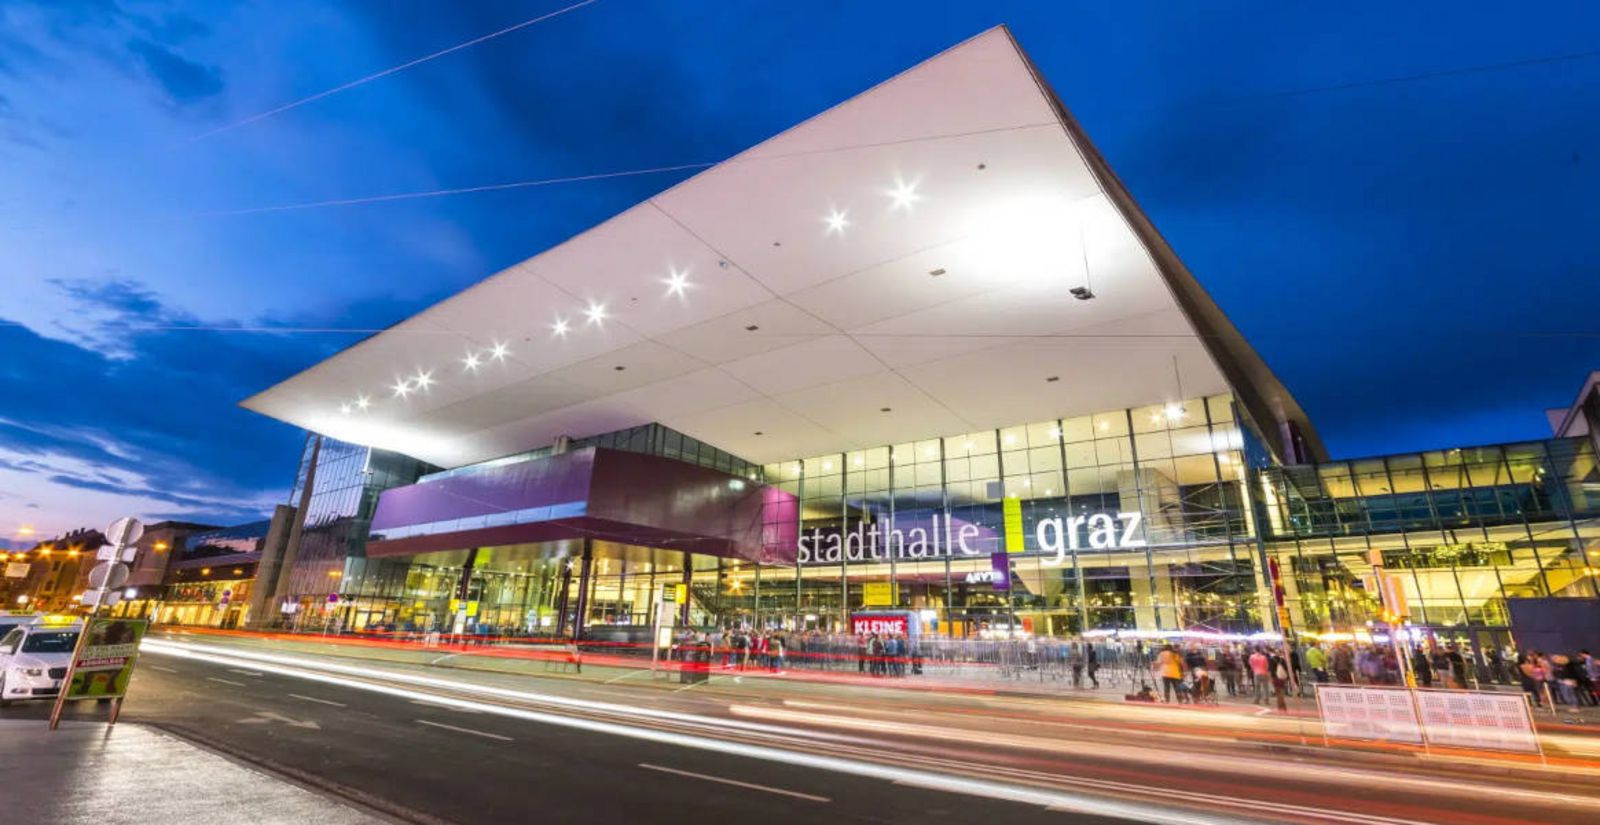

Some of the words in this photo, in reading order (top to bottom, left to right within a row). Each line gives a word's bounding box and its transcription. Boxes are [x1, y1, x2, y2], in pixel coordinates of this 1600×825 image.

[797, 513, 980, 563] stadthalle
[1036, 511, 1146, 566] graz
[854, 620, 903, 634] KLEINE
